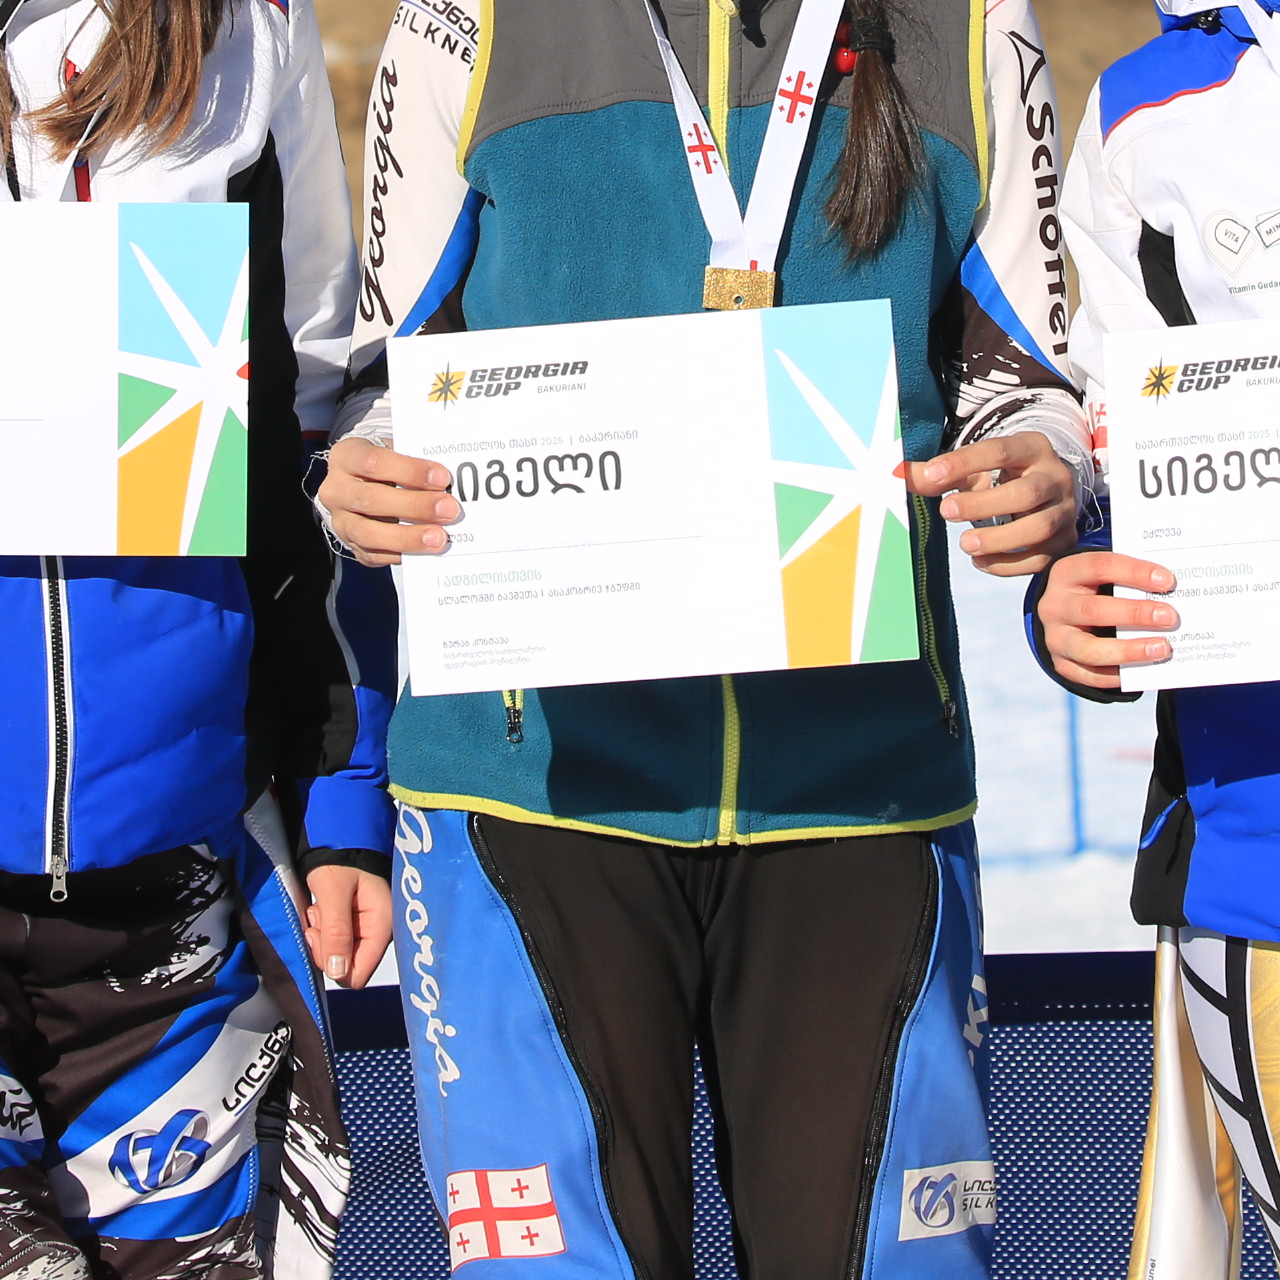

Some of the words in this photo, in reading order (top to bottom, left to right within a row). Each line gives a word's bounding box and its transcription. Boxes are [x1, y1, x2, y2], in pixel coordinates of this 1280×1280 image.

[360, 59, 404, 327] Georgia
[1224, 229, 1240, 243] VITA
[1228, 283, 1256, 295] Vitamin
[469, 361, 588, 383] GEORGIA
[465, 381, 522, 399] CUP
[537, 383, 587, 394] BAKURIANI
[1177, 375, 1231, 393] CUP
[540, 436, 564, 446] 2025
[1248, 429, 1270, 439] 2025
[447, 450, 621, 502] იგელი
[395, 800, 461, 1098] Georgia
